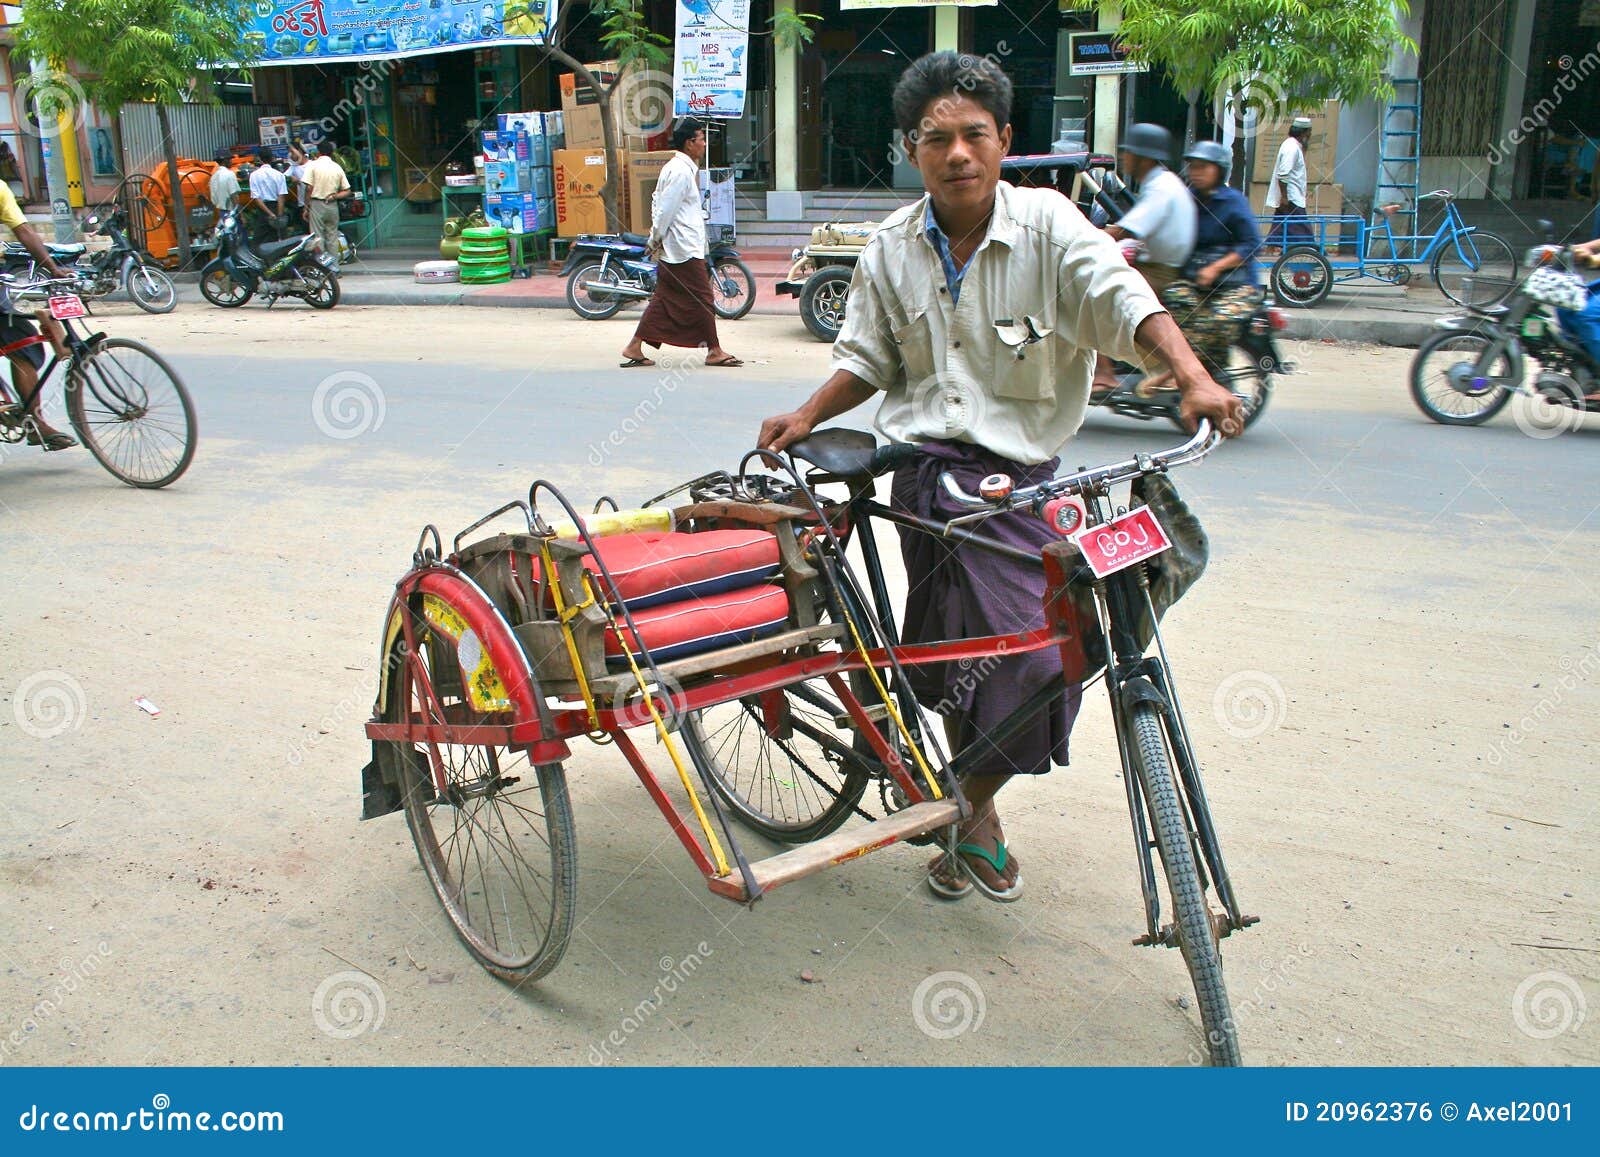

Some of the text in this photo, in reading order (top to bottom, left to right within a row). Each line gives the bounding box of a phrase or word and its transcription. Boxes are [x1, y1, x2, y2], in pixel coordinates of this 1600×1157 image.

[701, 44, 719, 52] MPS
[1078, 44, 1110, 55] TATA
[682, 61, 698, 74] TV
[555, 165, 567, 223] TOSHIBA
